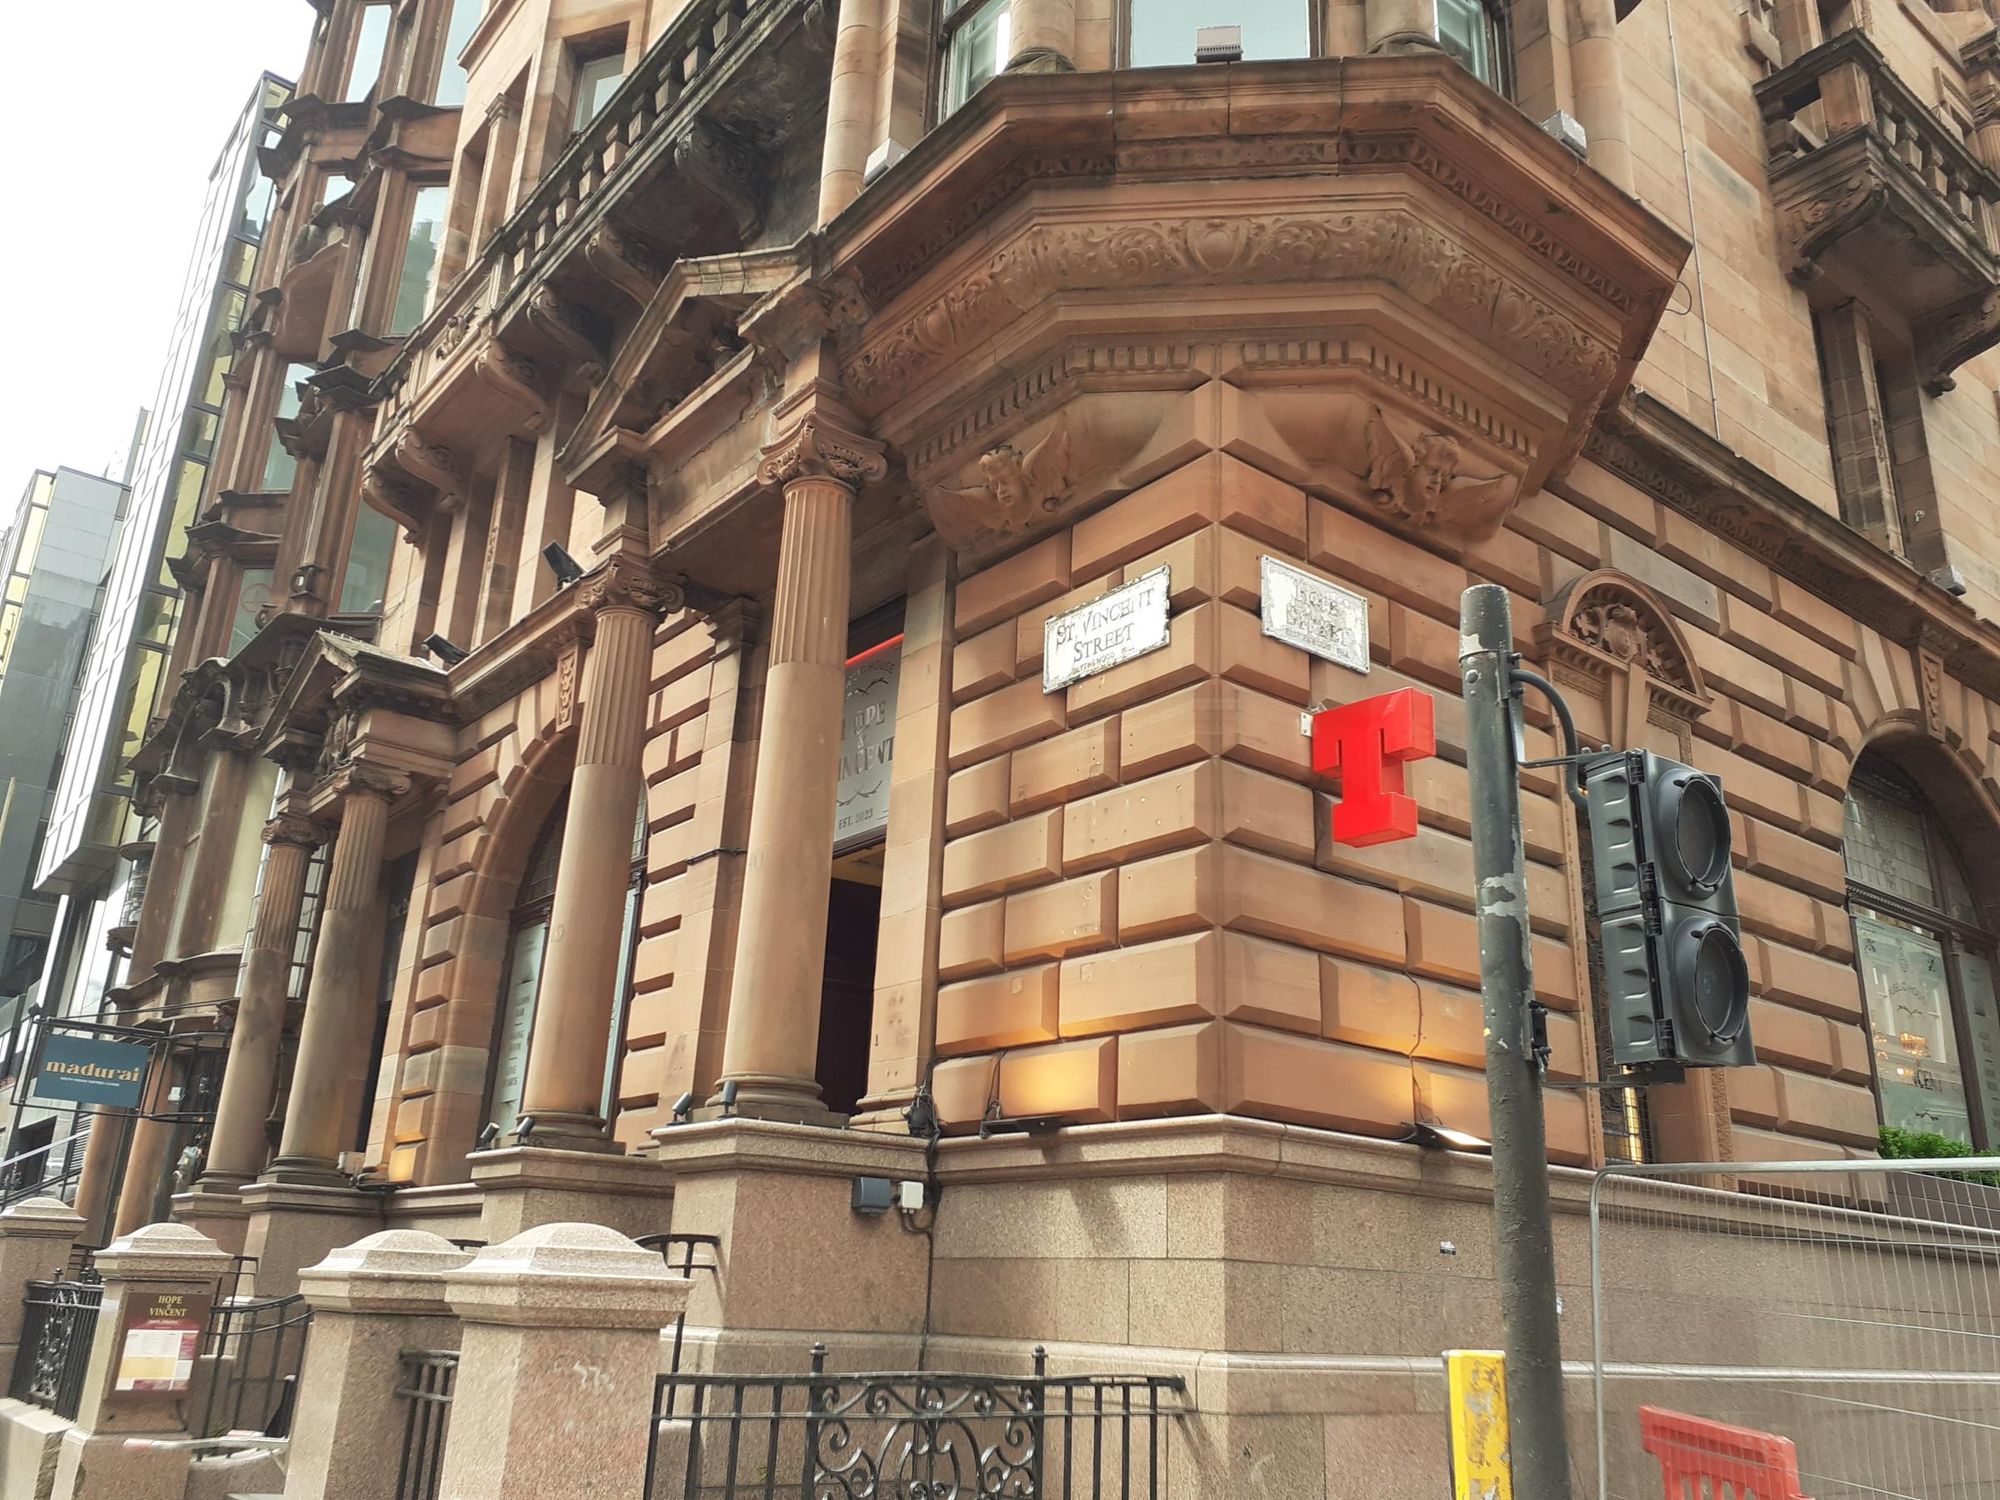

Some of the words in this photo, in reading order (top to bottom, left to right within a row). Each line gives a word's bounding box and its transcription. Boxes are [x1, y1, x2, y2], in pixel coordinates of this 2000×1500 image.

[1083, 588, 1154, 634] VINCENT
[1073, 622, 1134, 663] STREET
[838, 736, 895, 782] INCENT
[46, 1061, 140, 1081] madurai
[149, 1308, 188, 1317] VINCENT
[158, 1295, 184, 1304] HOPE
